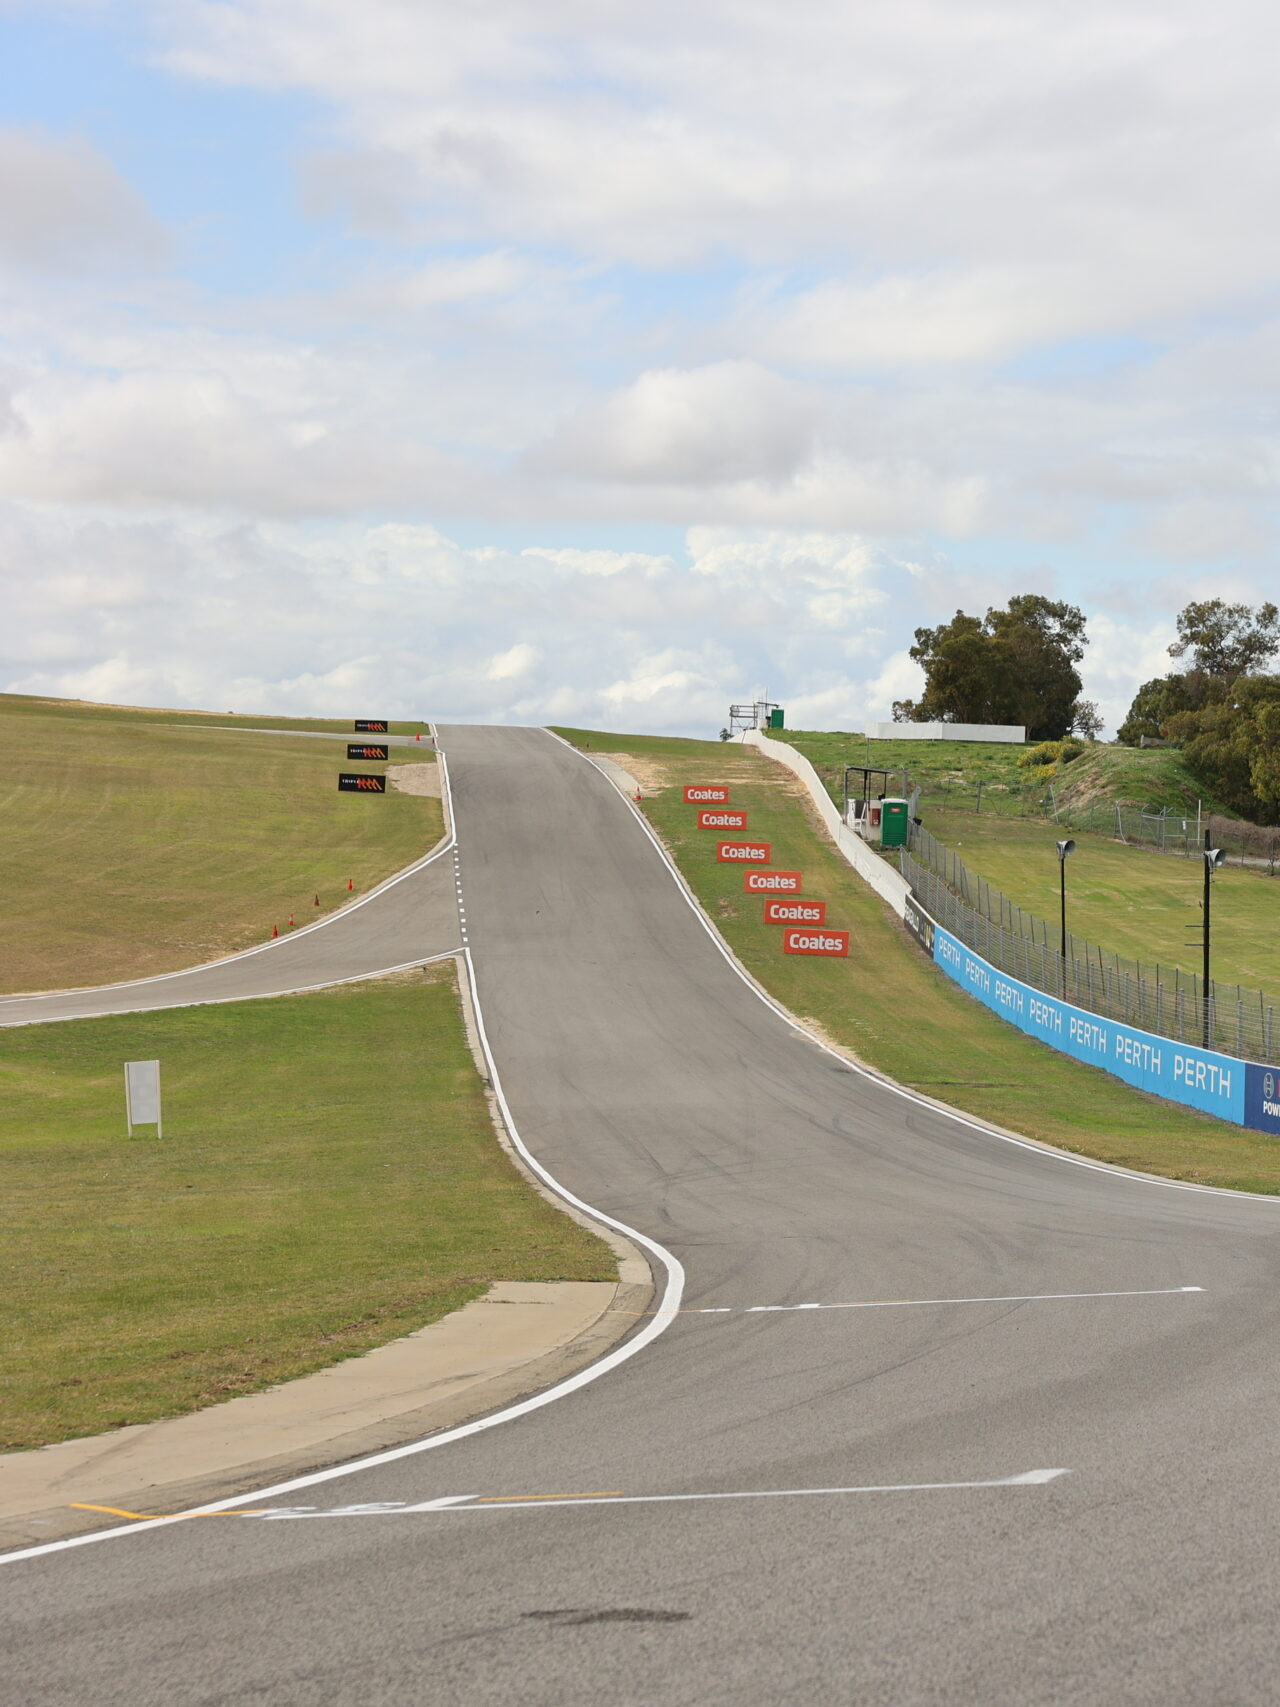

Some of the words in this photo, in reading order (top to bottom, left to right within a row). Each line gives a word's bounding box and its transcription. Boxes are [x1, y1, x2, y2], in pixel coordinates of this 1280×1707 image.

[687, 789, 725, 800] Coates
[702, 813, 742, 826] Coates
[721, 845, 766, 859] Coates
[749, 874, 797, 889] Coates
[770, 904, 820, 920] Coates
[789, 933, 843, 951] Coates
[939, 936, 960, 968] PERTH
[966, 958, 991, 993] PERTH
[995, 980, 1024, 1013] PERTH
[1030, 998, 1062, 1033] PERTH
[1069, 1017, 1107, 1053] PERTH
[1115, 1034, 1161, 1075] PERTH
[1174, 1055, 1231, 1098] PERTH
